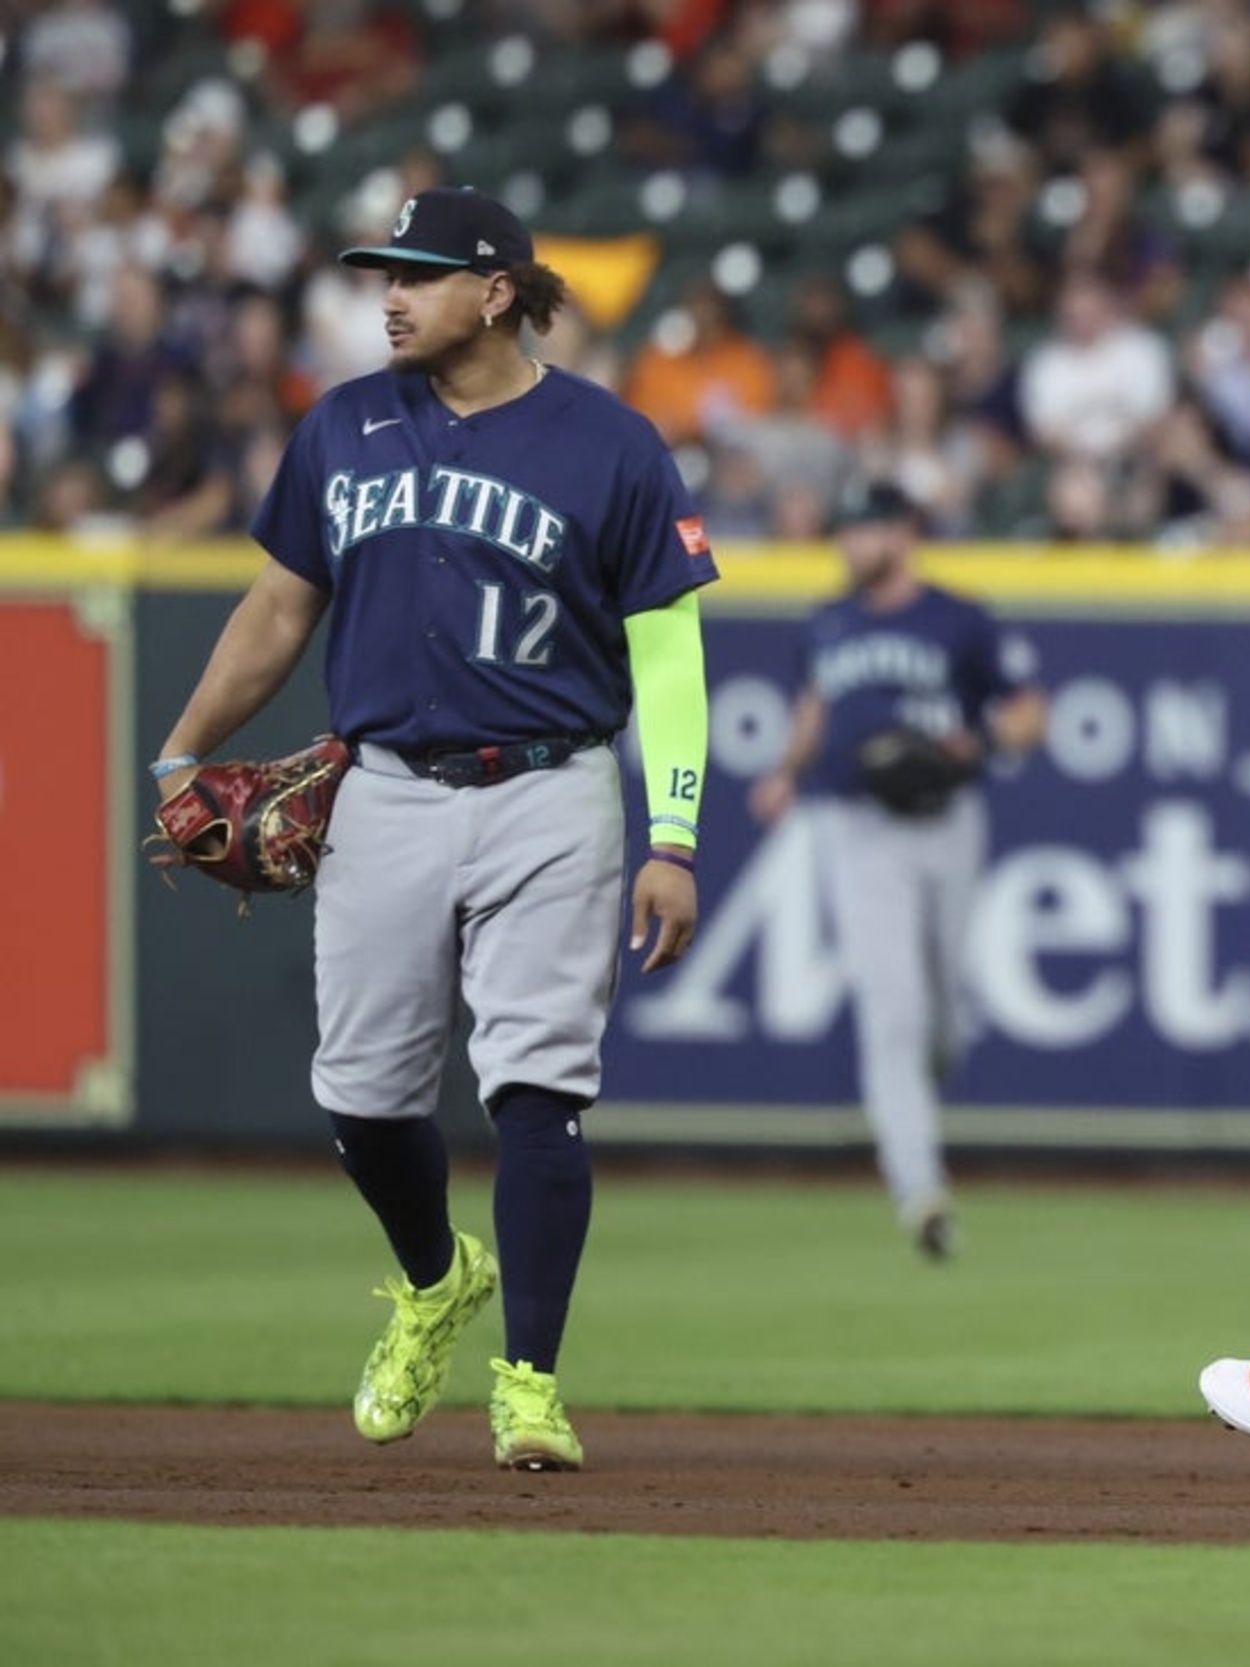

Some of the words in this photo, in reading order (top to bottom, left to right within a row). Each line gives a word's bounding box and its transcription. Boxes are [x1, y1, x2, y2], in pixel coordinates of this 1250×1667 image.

[325, 467, 566, 571] SEATTLE
[474, 583, 559, 667] 12
[527, 745, 550, 767] 12
[668, 767, 697, 801] 12
